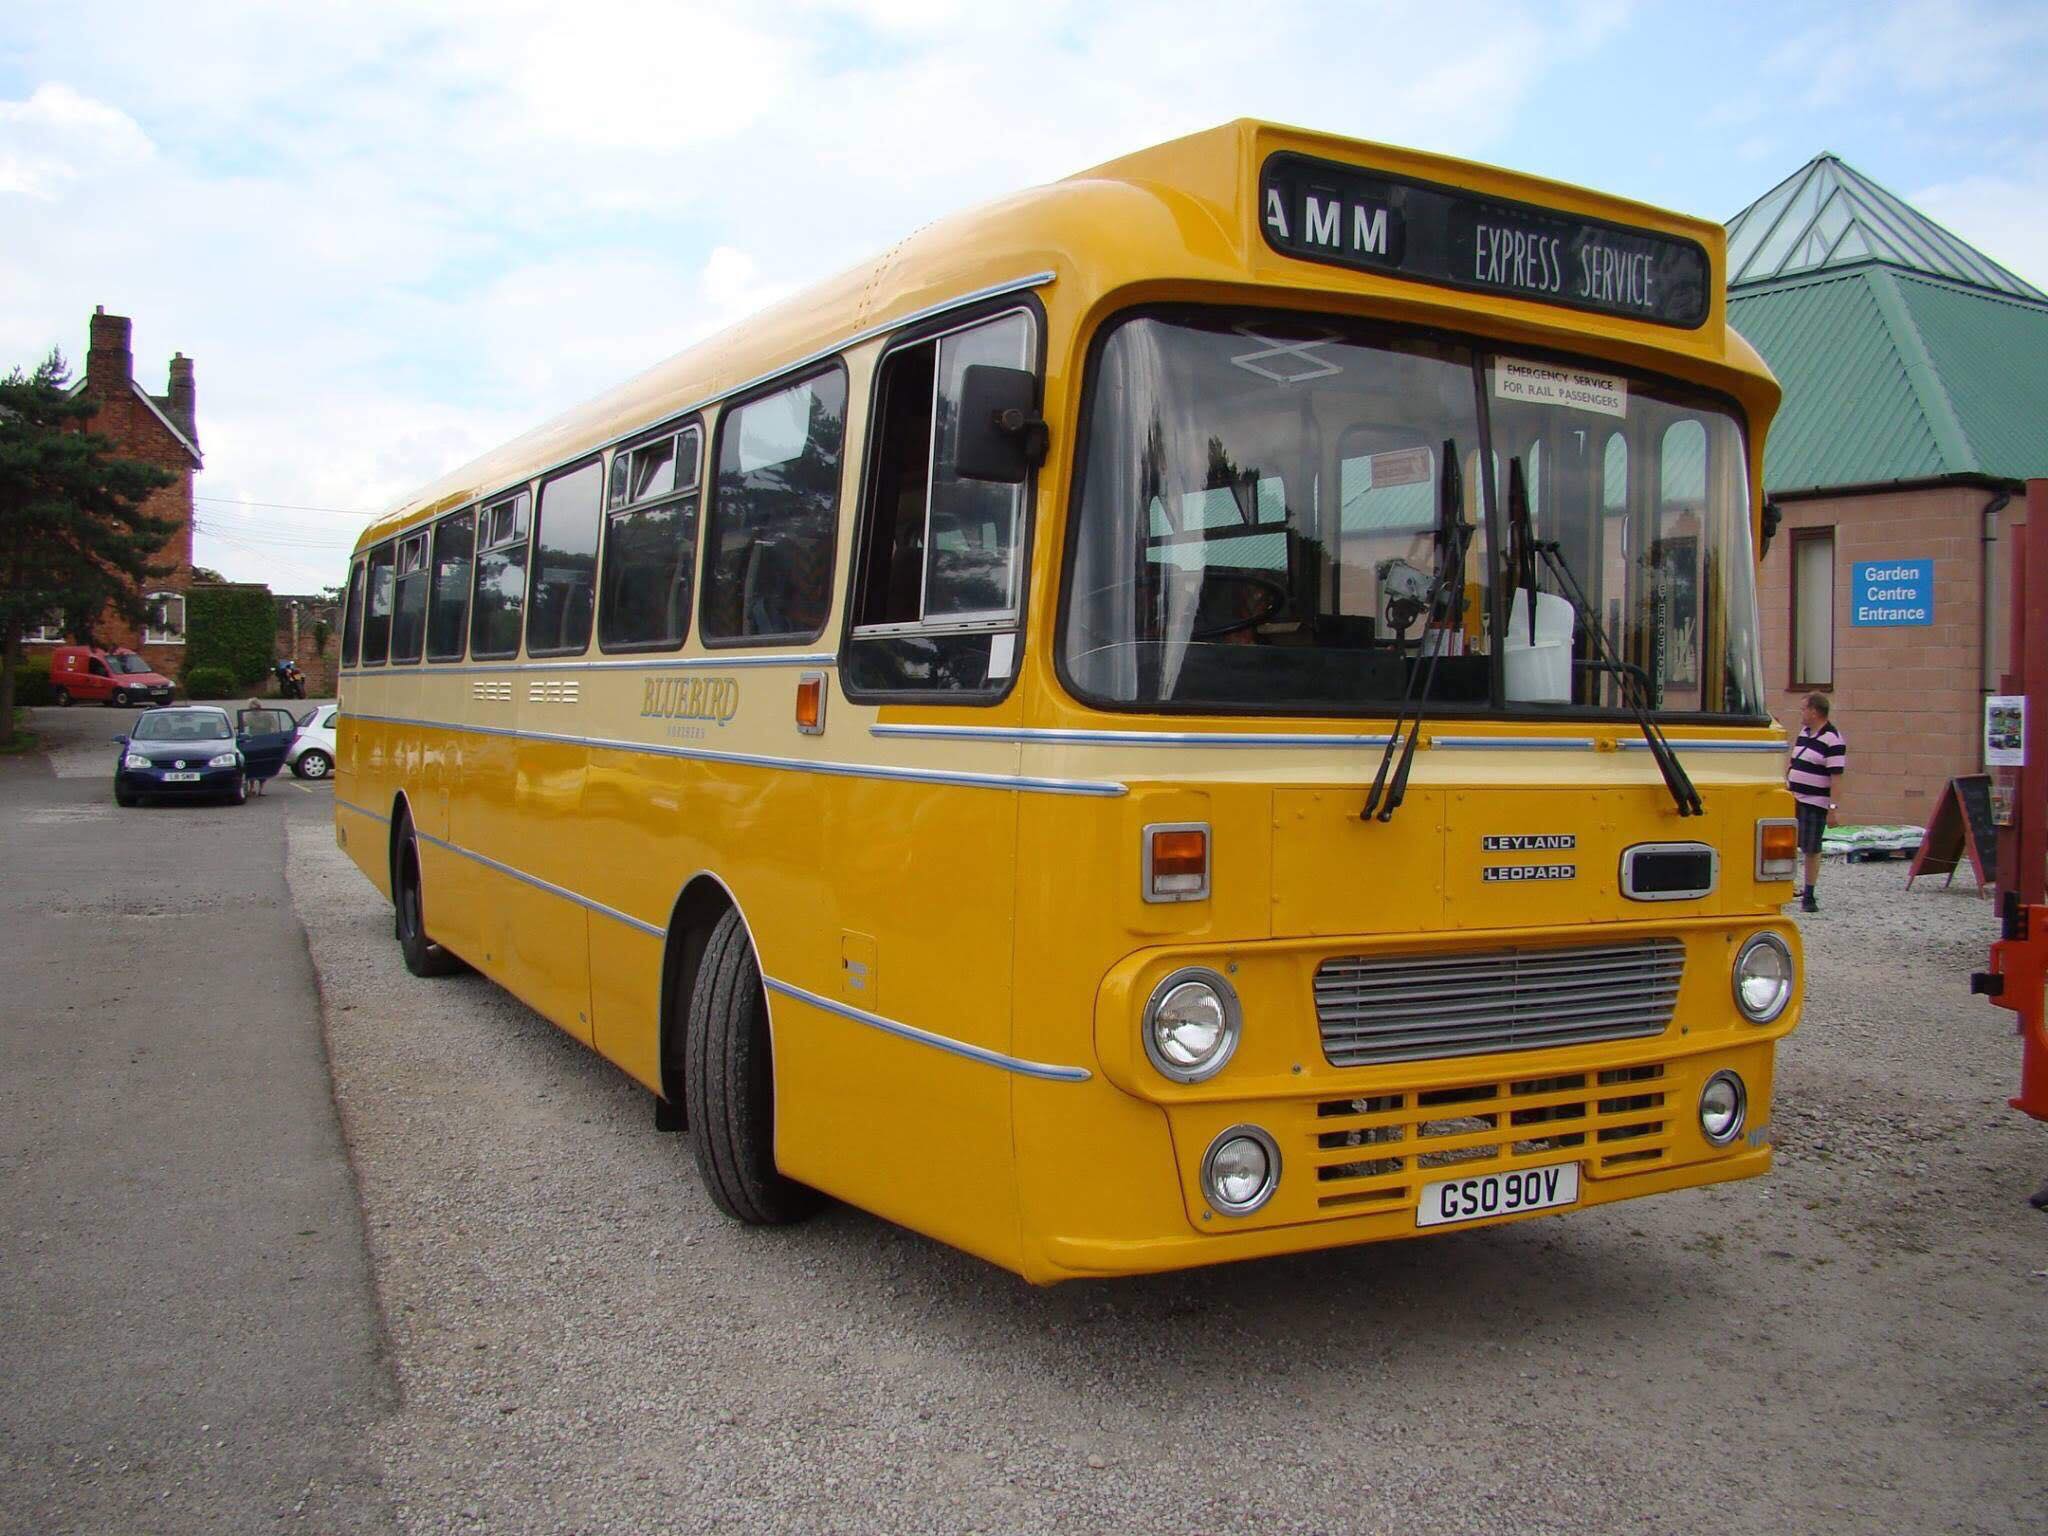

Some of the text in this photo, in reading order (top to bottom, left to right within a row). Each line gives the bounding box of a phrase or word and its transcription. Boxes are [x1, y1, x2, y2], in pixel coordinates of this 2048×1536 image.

[1475, 223, 1654, 307] EXPRESS SERVICE
[1507, 364, 1614, 391] EMERGENCY SERVICE
[1503, 380, 1619, 408] FOR RAIL PASSENGERS
[1864, 566, 1920, 582] Garden
[1867, 587, 1917, 601] Centre
[1858, 606, 1926, 621] Entrance
[640, 677, 739, 727] BLUEBIRD
[1487, 836, 1572, 850] LEYLAND
[1487, 866, 1572, 881] LEOPARD
